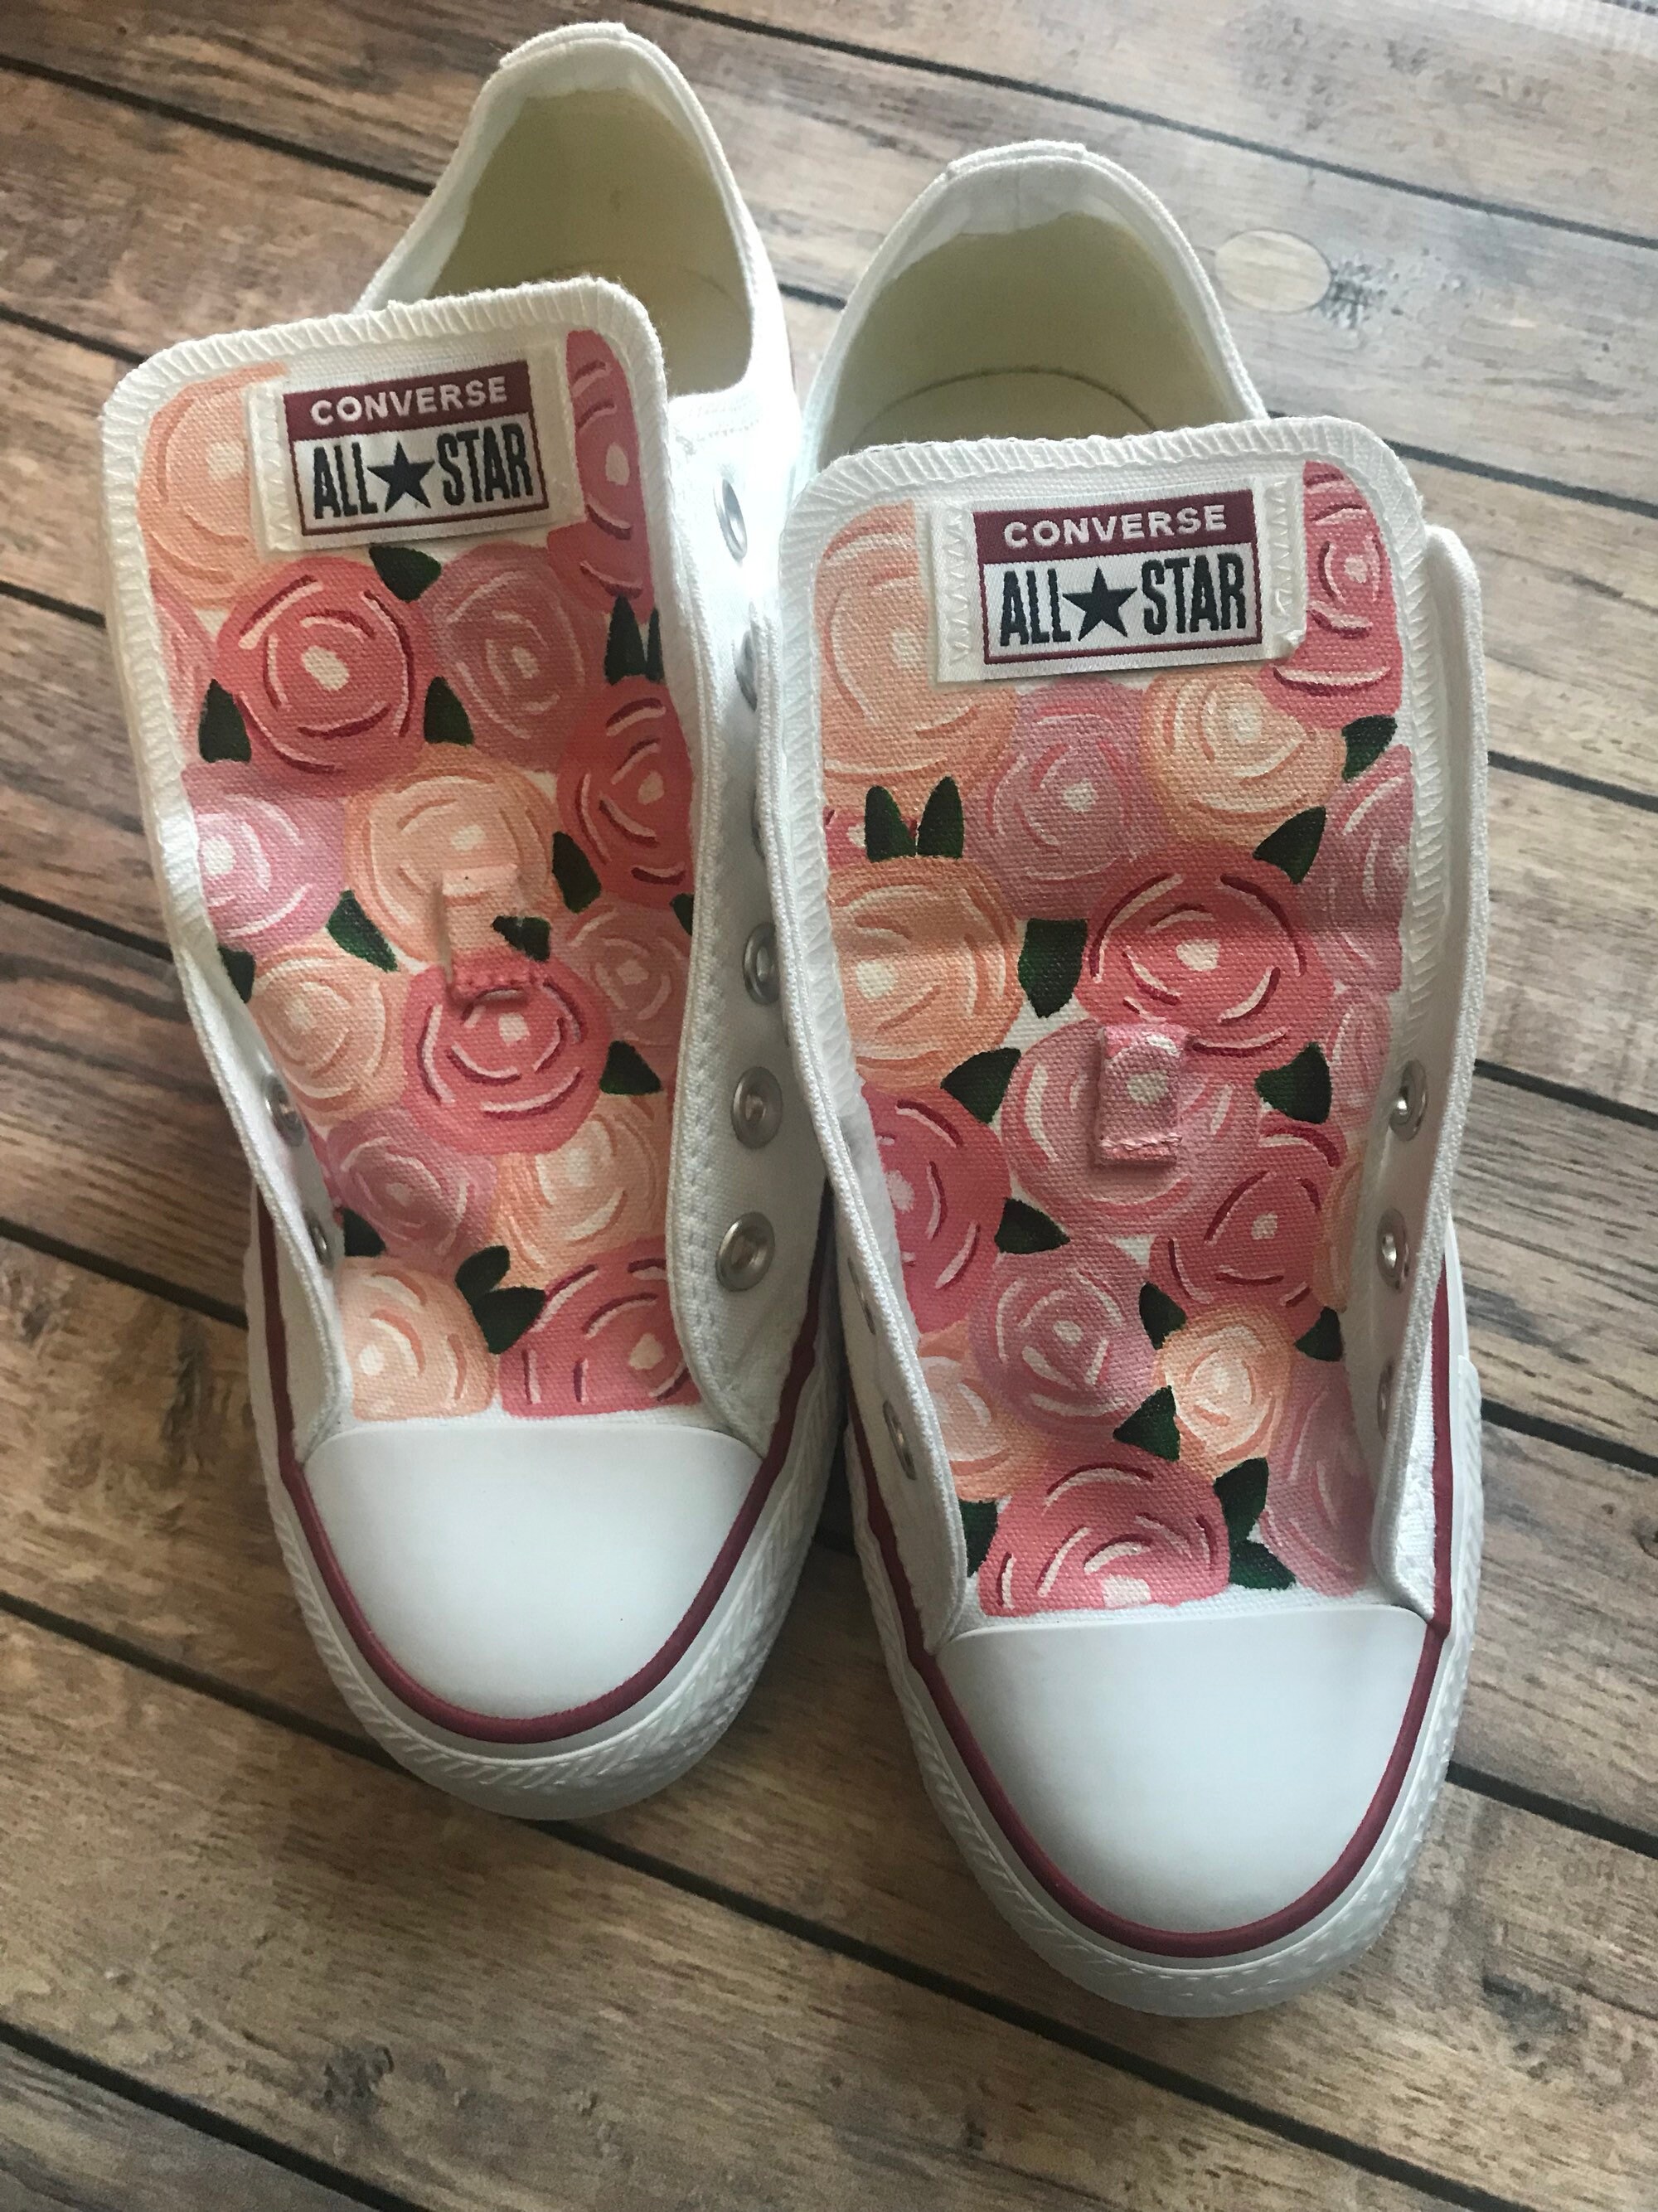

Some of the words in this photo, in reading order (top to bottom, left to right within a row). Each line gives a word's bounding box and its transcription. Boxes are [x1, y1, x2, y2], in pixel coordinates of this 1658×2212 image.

[310, 376, 507, 425] CONVERSE
[313, 442, 378, 520] ALL
[436, 423, 533, 506] STAR
[1003, 504, 1227, 549] CONVERSE
[1000, 568, 1071, 647] ALL
[1141, 552, 1247, 635] STAR
